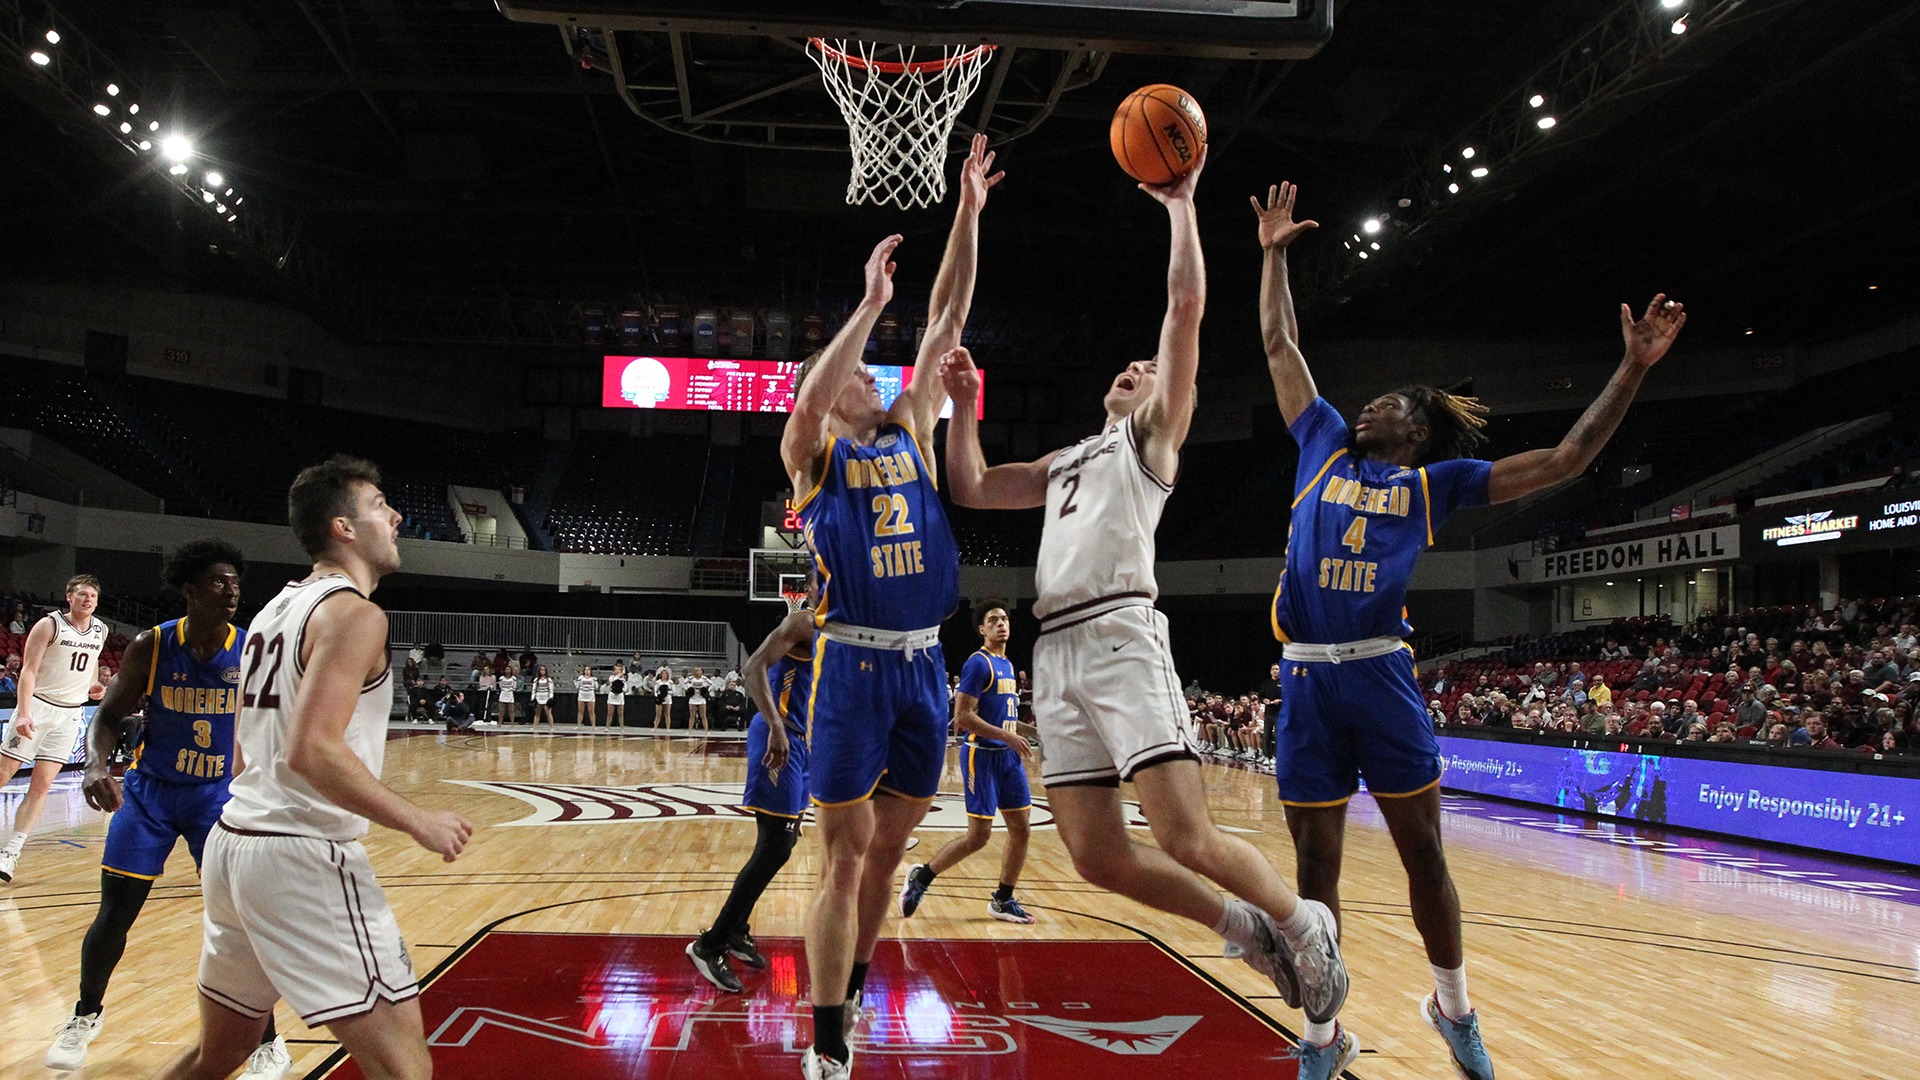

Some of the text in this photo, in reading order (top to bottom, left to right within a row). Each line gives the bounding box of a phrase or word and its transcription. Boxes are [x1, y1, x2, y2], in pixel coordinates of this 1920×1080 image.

[1059, 473, 1080, 519] 2
[1321, 475, 1411, 517] MOREHEAD
[872, 493, 915, 537] 22
[1763, 524, 1805, 540] FITNESS
[1811, 516, 1859, 533] MARKET
[1869, 515, 1918, 531] HOME AND
[1342, 516, 1368, 554] 4
[870, 540, 925, 578] STATE
[1545, 532, 1725, 578] FREEDOM HALL
[1318, 557, 1378, 592] STATE
[60, 639, 101, 650] BELLARMINE
[69, 651, 90, 672] 10
[243, 632, 285, 709] 22
[161, 686, 235, 714] MOREHEA
[192, 719, 212, 748] 3
[175, 748, 225, 778] STATE
[1451, 755, 1504, 779] Responsibly
[1505, 761, 1523, 777] 21+
[1699, 784, 1906, 828] Enjoy Responsibly 21+
